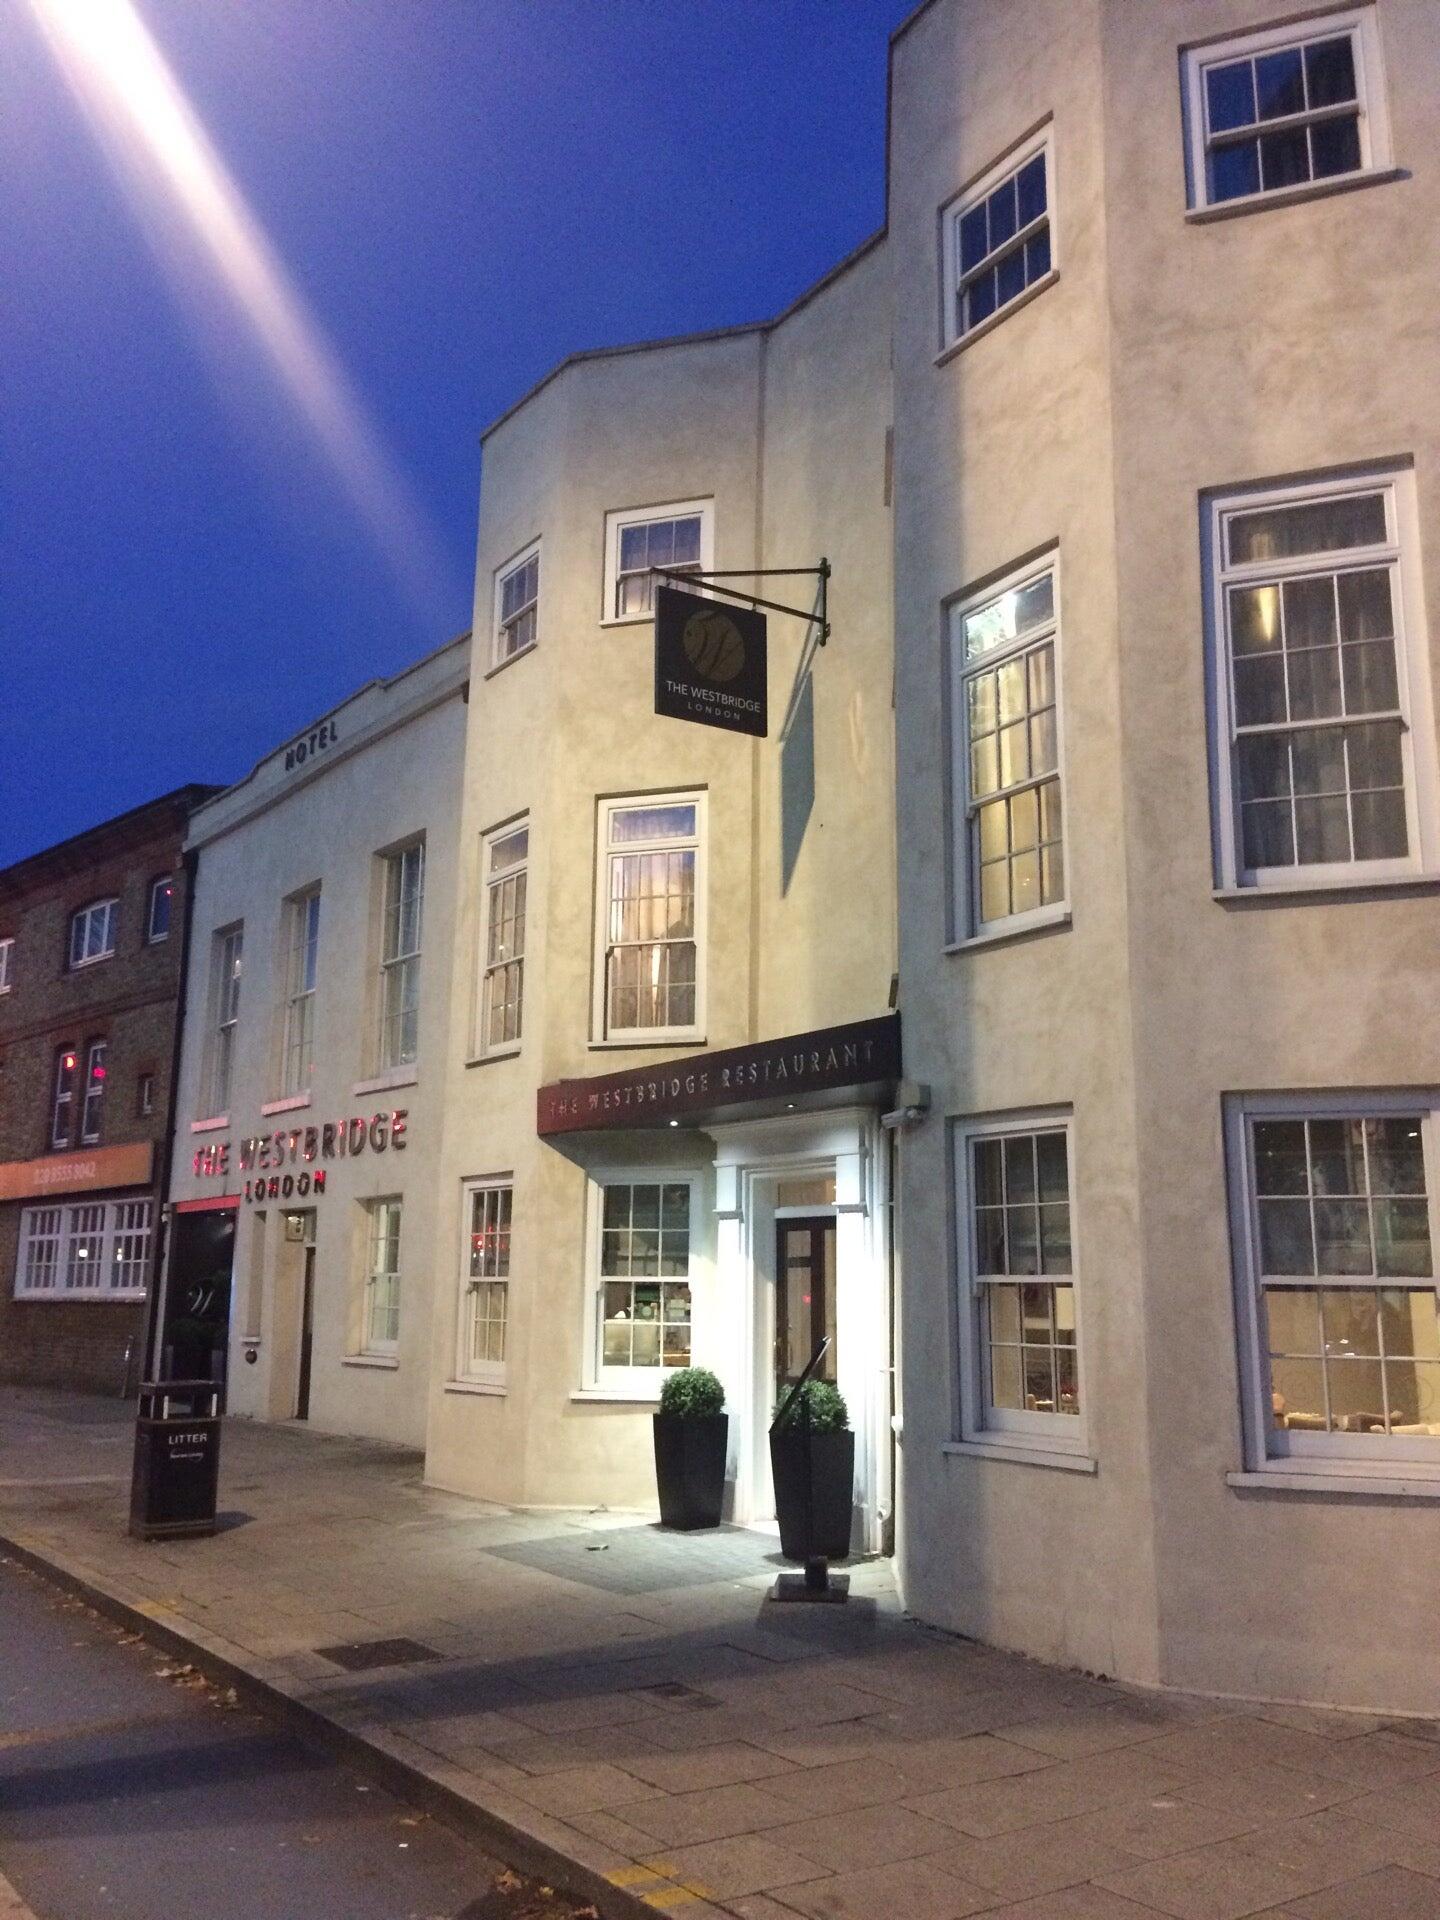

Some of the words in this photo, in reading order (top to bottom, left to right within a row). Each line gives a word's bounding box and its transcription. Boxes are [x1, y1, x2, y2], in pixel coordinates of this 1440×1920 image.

[665, 681, 689, 696] THE
[690, 686, 762, 713] WESTBRIDGE
[687, 702, 741, 721] LONDON
[285, 721, 338, 771] HOTEL
[549, 1097, 578, 1116] THE
[588, 1073, 708, 1111] WESTBRIDGE
[721, 1040, 875, 1087] RESTAURANT
[192, 1142, 231, 1176] THE
[239, 1109, 409, 1170] WESTBRIDGE
[244, 1169, 327, 1204] LONDON
[168, 1432, 208, 1445] LITTER
